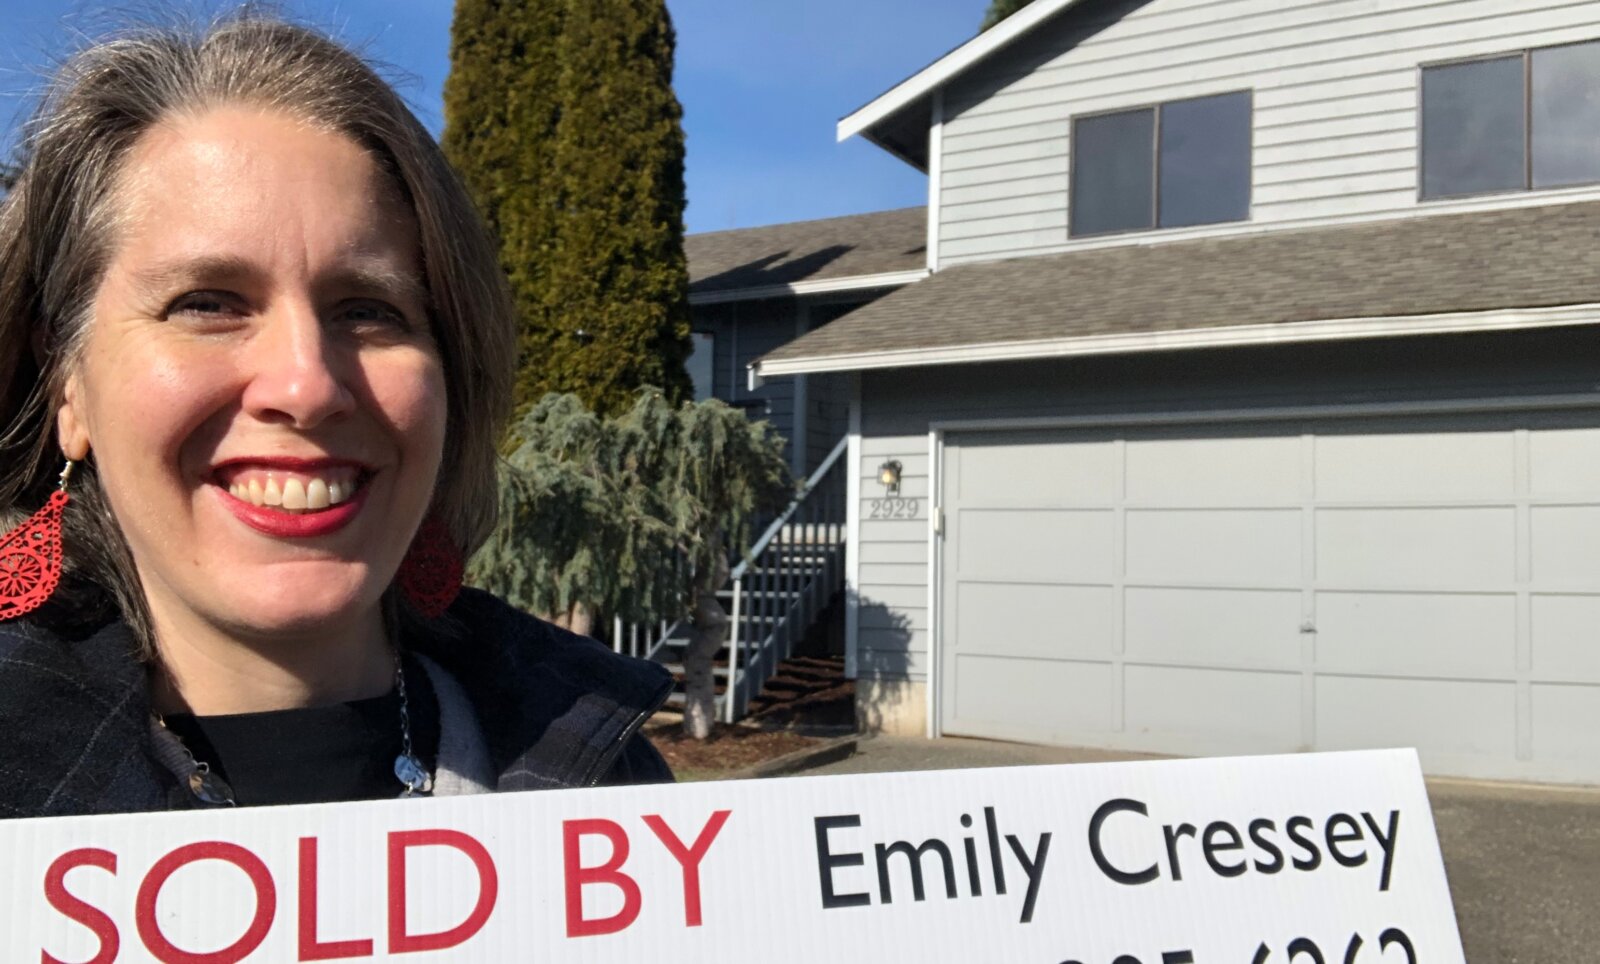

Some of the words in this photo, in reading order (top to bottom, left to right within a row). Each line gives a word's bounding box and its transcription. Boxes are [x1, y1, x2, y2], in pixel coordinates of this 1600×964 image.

[869, 500, 919, 519] 2929
[42, 829, 498, 964] SOLD
[563, 810, 731, 937] BY
[815, 807, 1051, 922] Emily
[1089, 799, 1399, 890] Cressey
